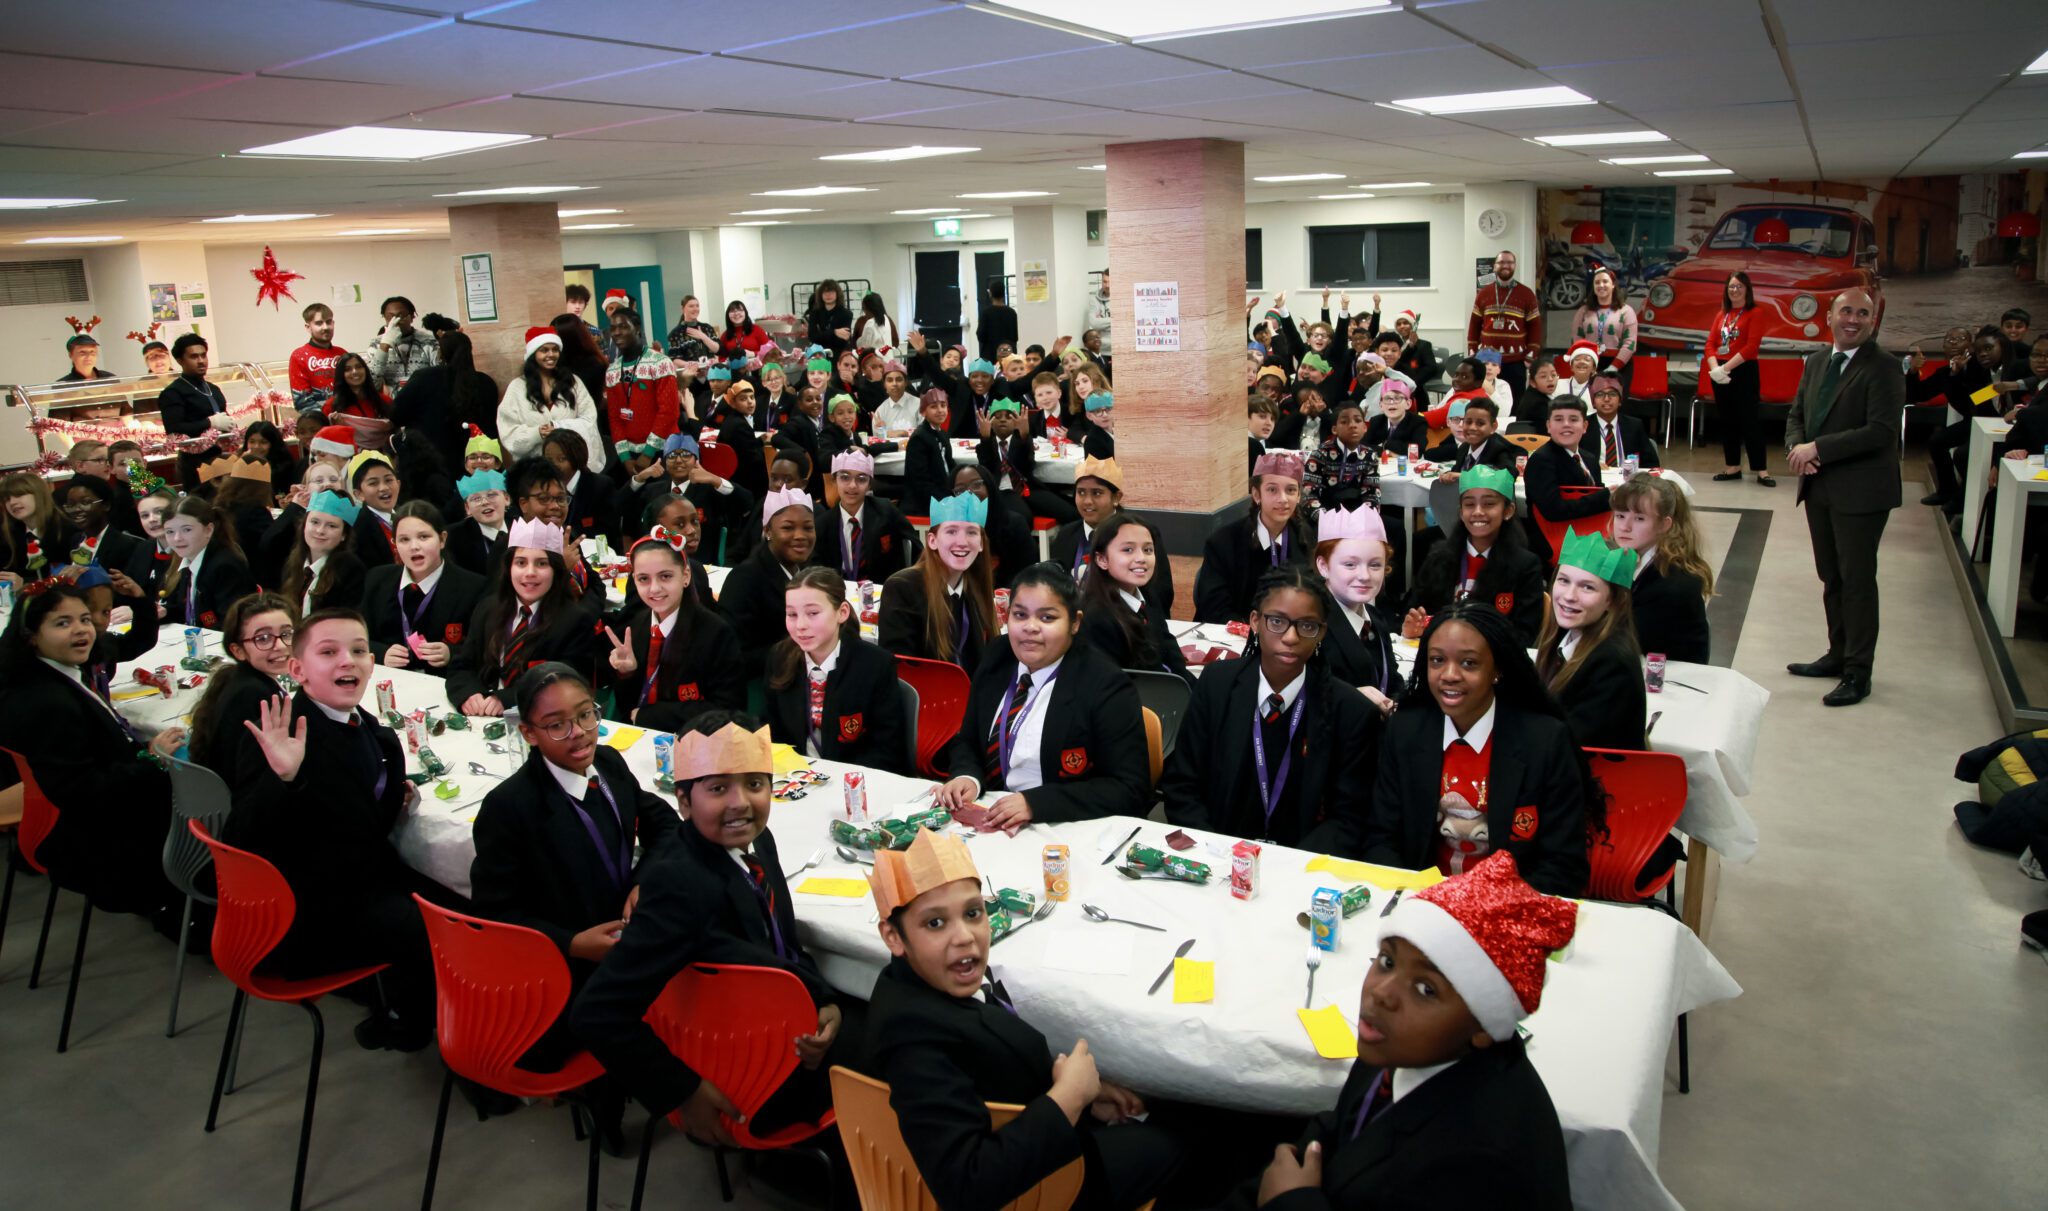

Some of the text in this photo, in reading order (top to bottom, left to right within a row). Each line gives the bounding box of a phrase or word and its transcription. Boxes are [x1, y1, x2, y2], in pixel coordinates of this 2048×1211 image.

[308, 355, 340, 371] Coca-C
[1294, 698, 1304, 719] STUDENT
[1256, 745, 1264, 766] STUDENT
[1232, 858, 1250, 867] adnor
